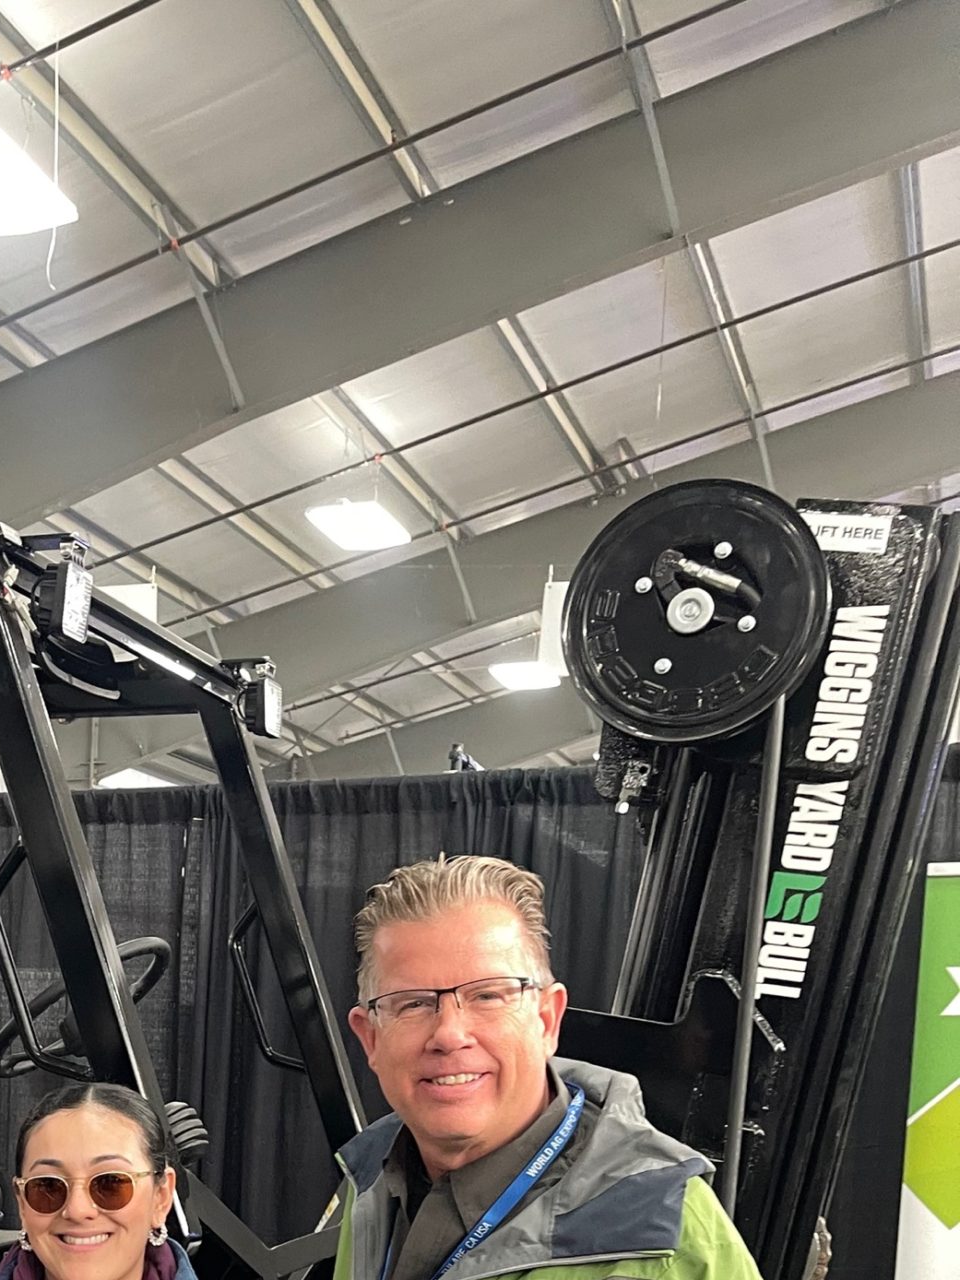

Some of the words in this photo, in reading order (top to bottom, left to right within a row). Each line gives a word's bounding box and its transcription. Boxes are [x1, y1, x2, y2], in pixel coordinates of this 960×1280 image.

[841, 527, 884, 540] HERE
[805, 604, 891, 765] WIGGINS
[780, 780, 850, 873] YARD
[526, 1147, 554, 1177] WORLD
[551, 1135, 563, 1150] AG
[465, 1231, 479, 1249] CA
[474, 1221, 493, 1240] USA
